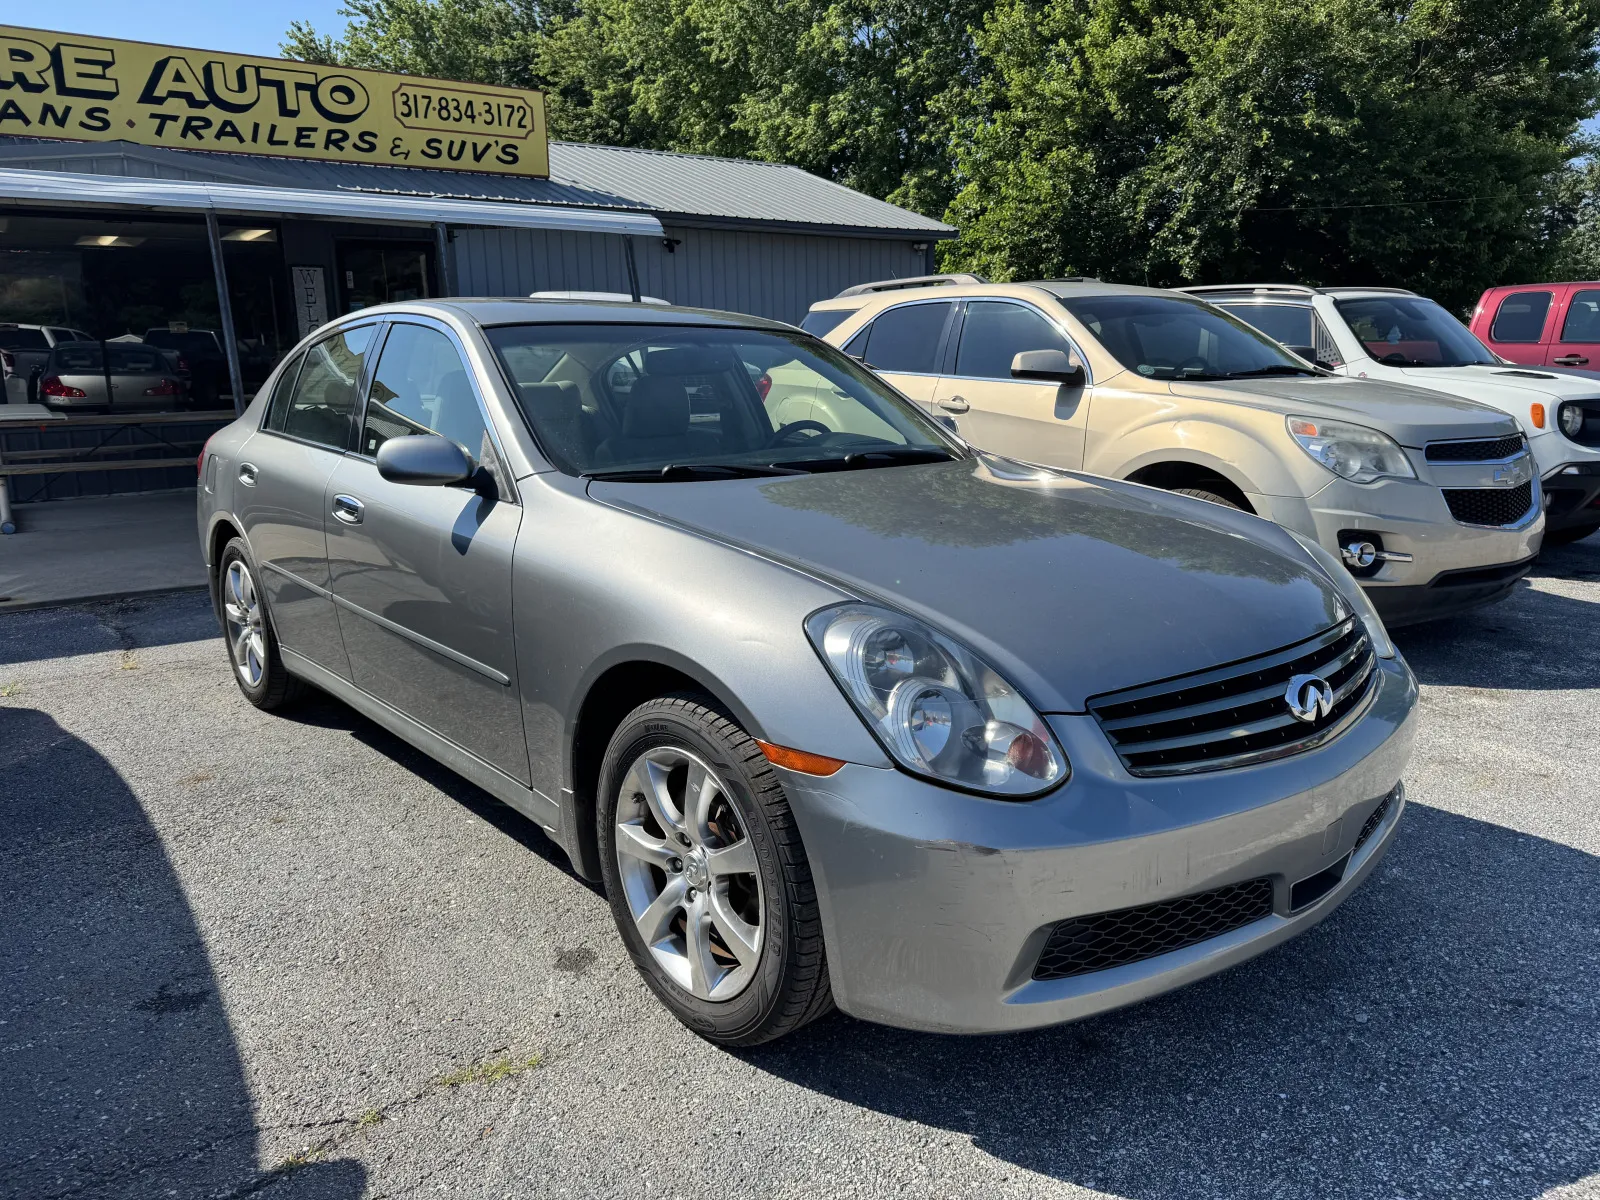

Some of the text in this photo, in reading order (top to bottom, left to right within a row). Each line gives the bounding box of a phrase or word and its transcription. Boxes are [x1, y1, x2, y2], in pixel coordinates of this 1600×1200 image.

[0, 36, 370, 124] RE AUTO
[148, 112, 379, 153] TRAILERS
[389, 136, 411, 161] &
[420, 137, 520, 165] SUV'S
